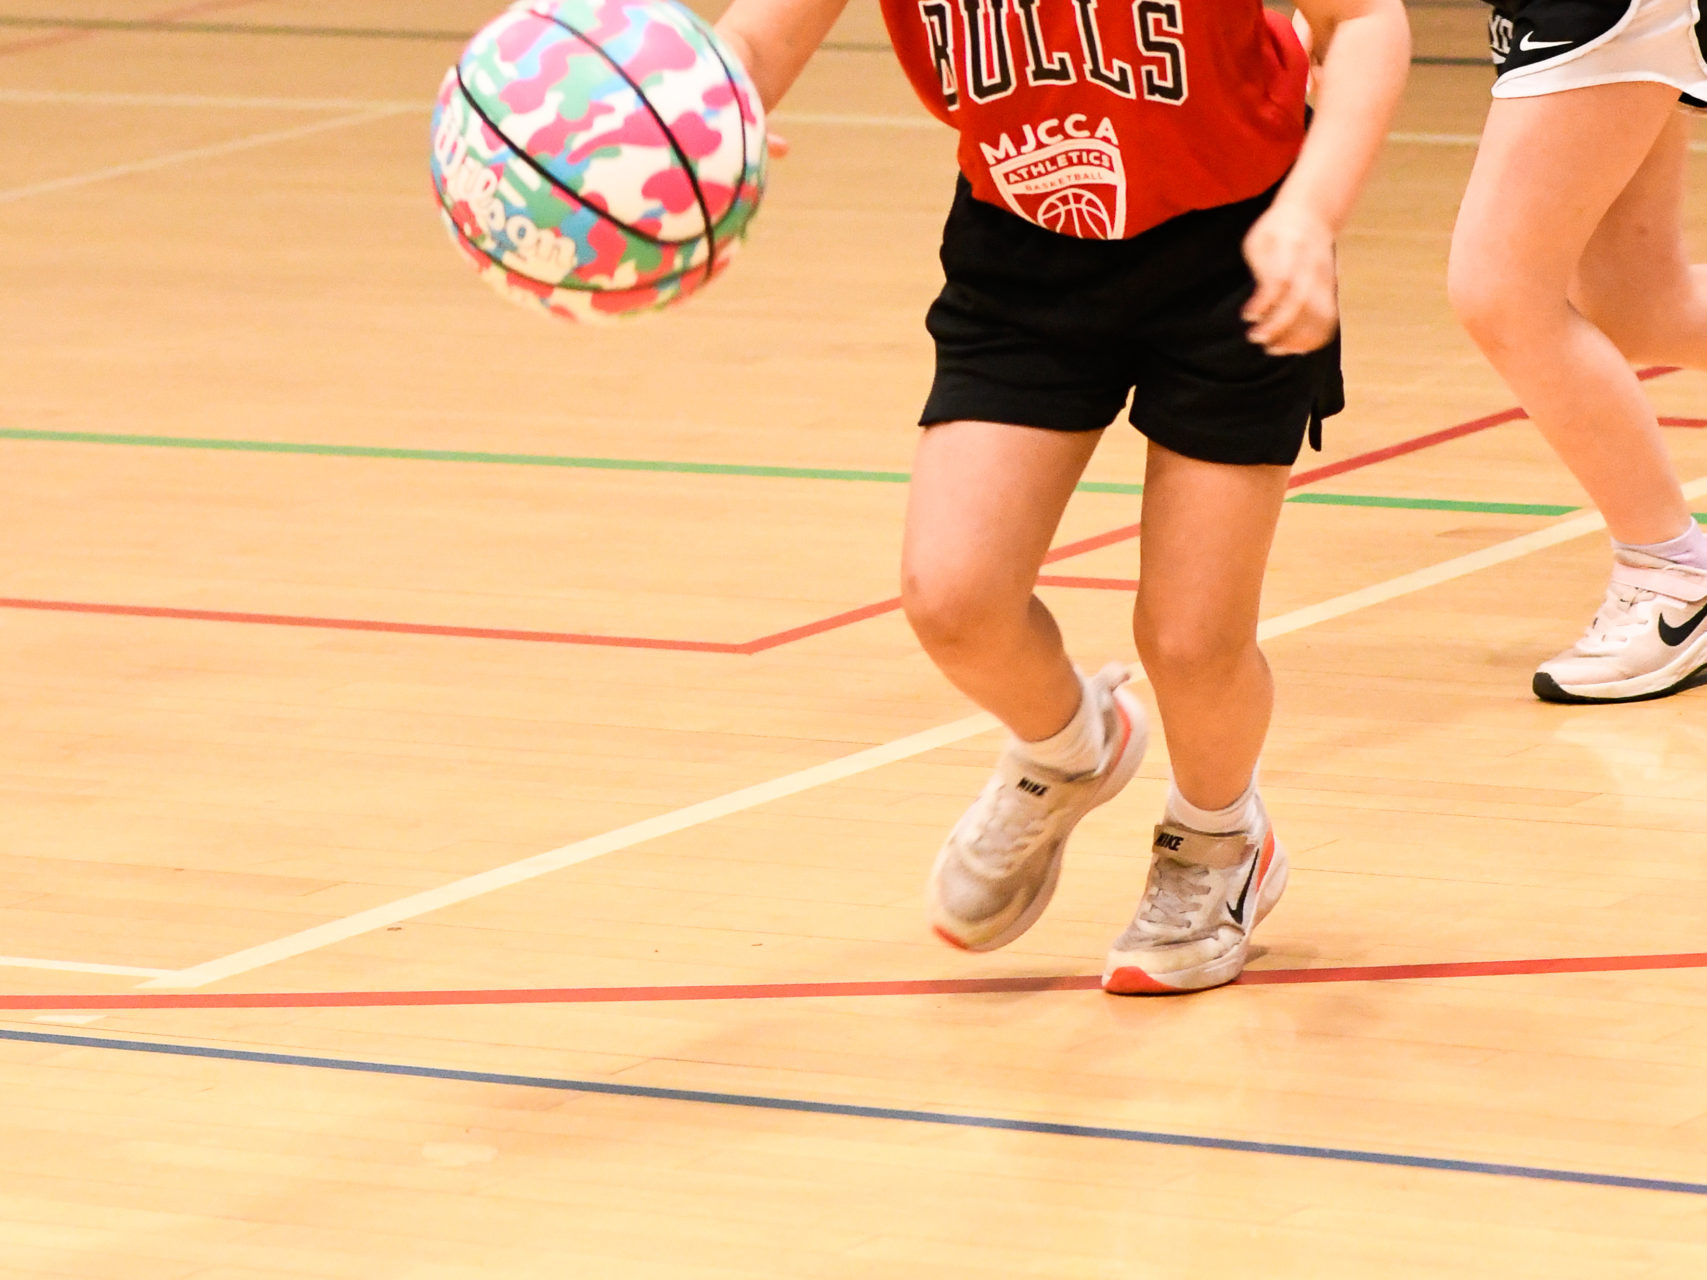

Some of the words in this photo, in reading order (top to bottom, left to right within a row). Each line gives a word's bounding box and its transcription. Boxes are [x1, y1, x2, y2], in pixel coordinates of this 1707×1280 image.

[978, 112, 1120, 166] MJCCA
[1008, 151, 1111, 185] ATHLETICS
[1024, 171, 1104, 192] BASKETBALL
[1154, 832, 1185, 852] NIKE
